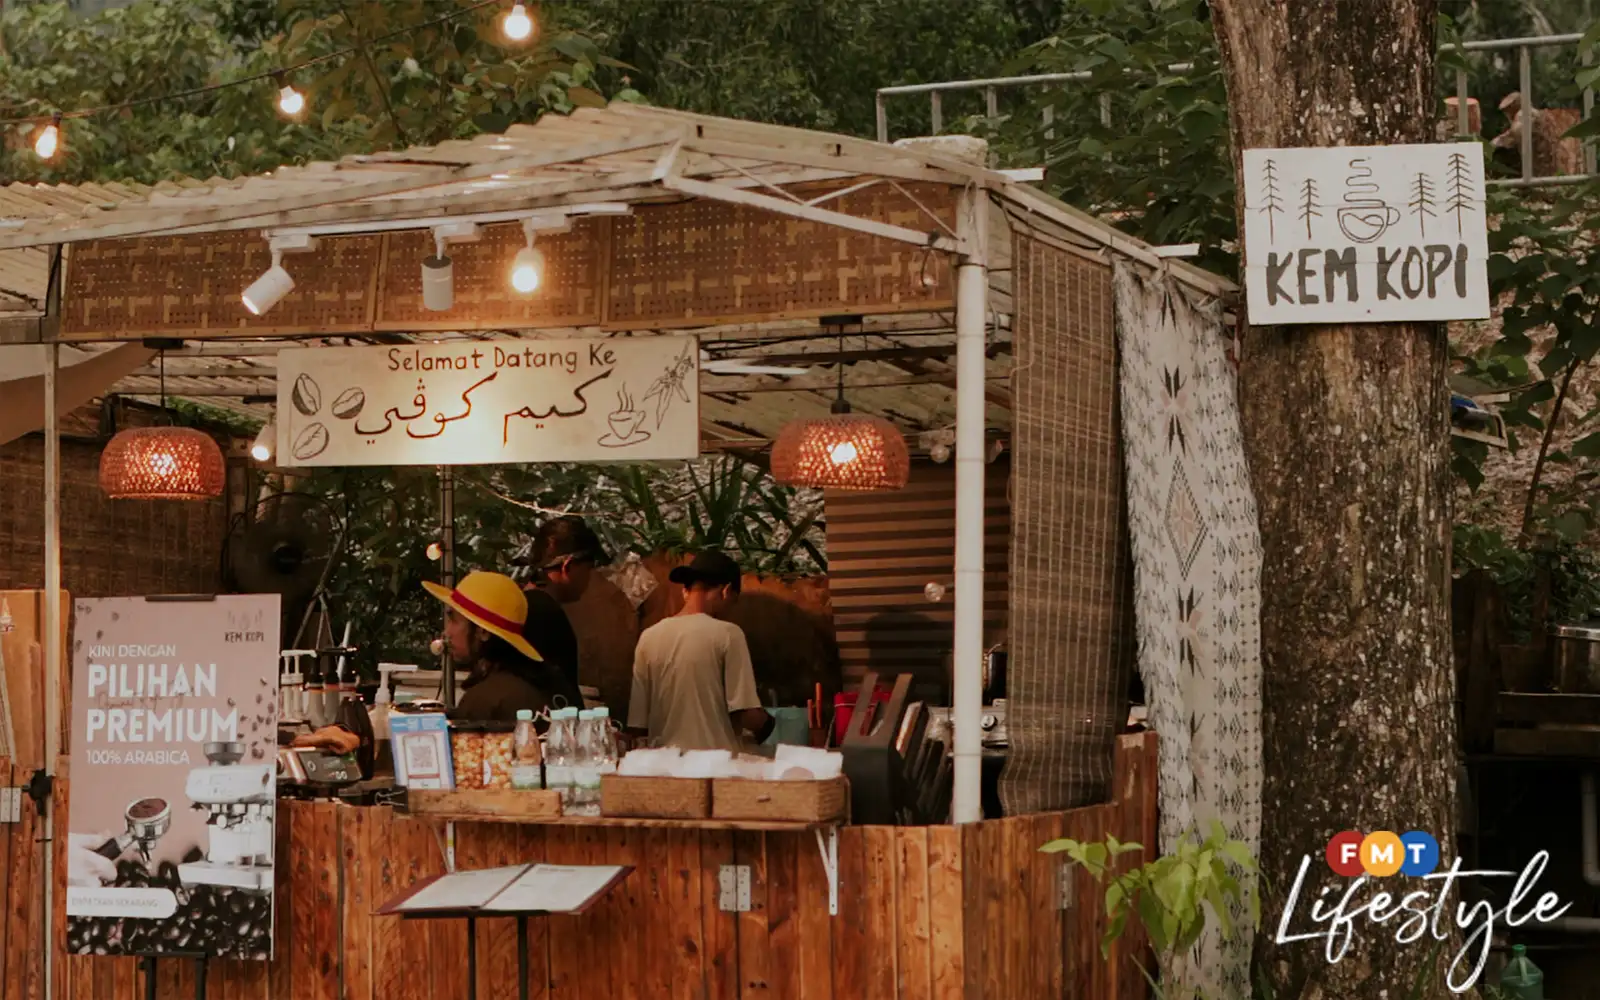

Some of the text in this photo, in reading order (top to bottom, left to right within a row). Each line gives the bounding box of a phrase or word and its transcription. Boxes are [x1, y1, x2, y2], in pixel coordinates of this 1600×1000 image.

[1266, 243, 1468, 306] KEM KOPI
[388, 342, 617, 374] Selamat Datang Ke
[88, 644, 176, 657] KINI DENGAN
[88, 663, 217, 698] PILIHAN
[86, 707, 238, 742] PREMIUM
[86, 750, 190, 765] 100% ARABICA
